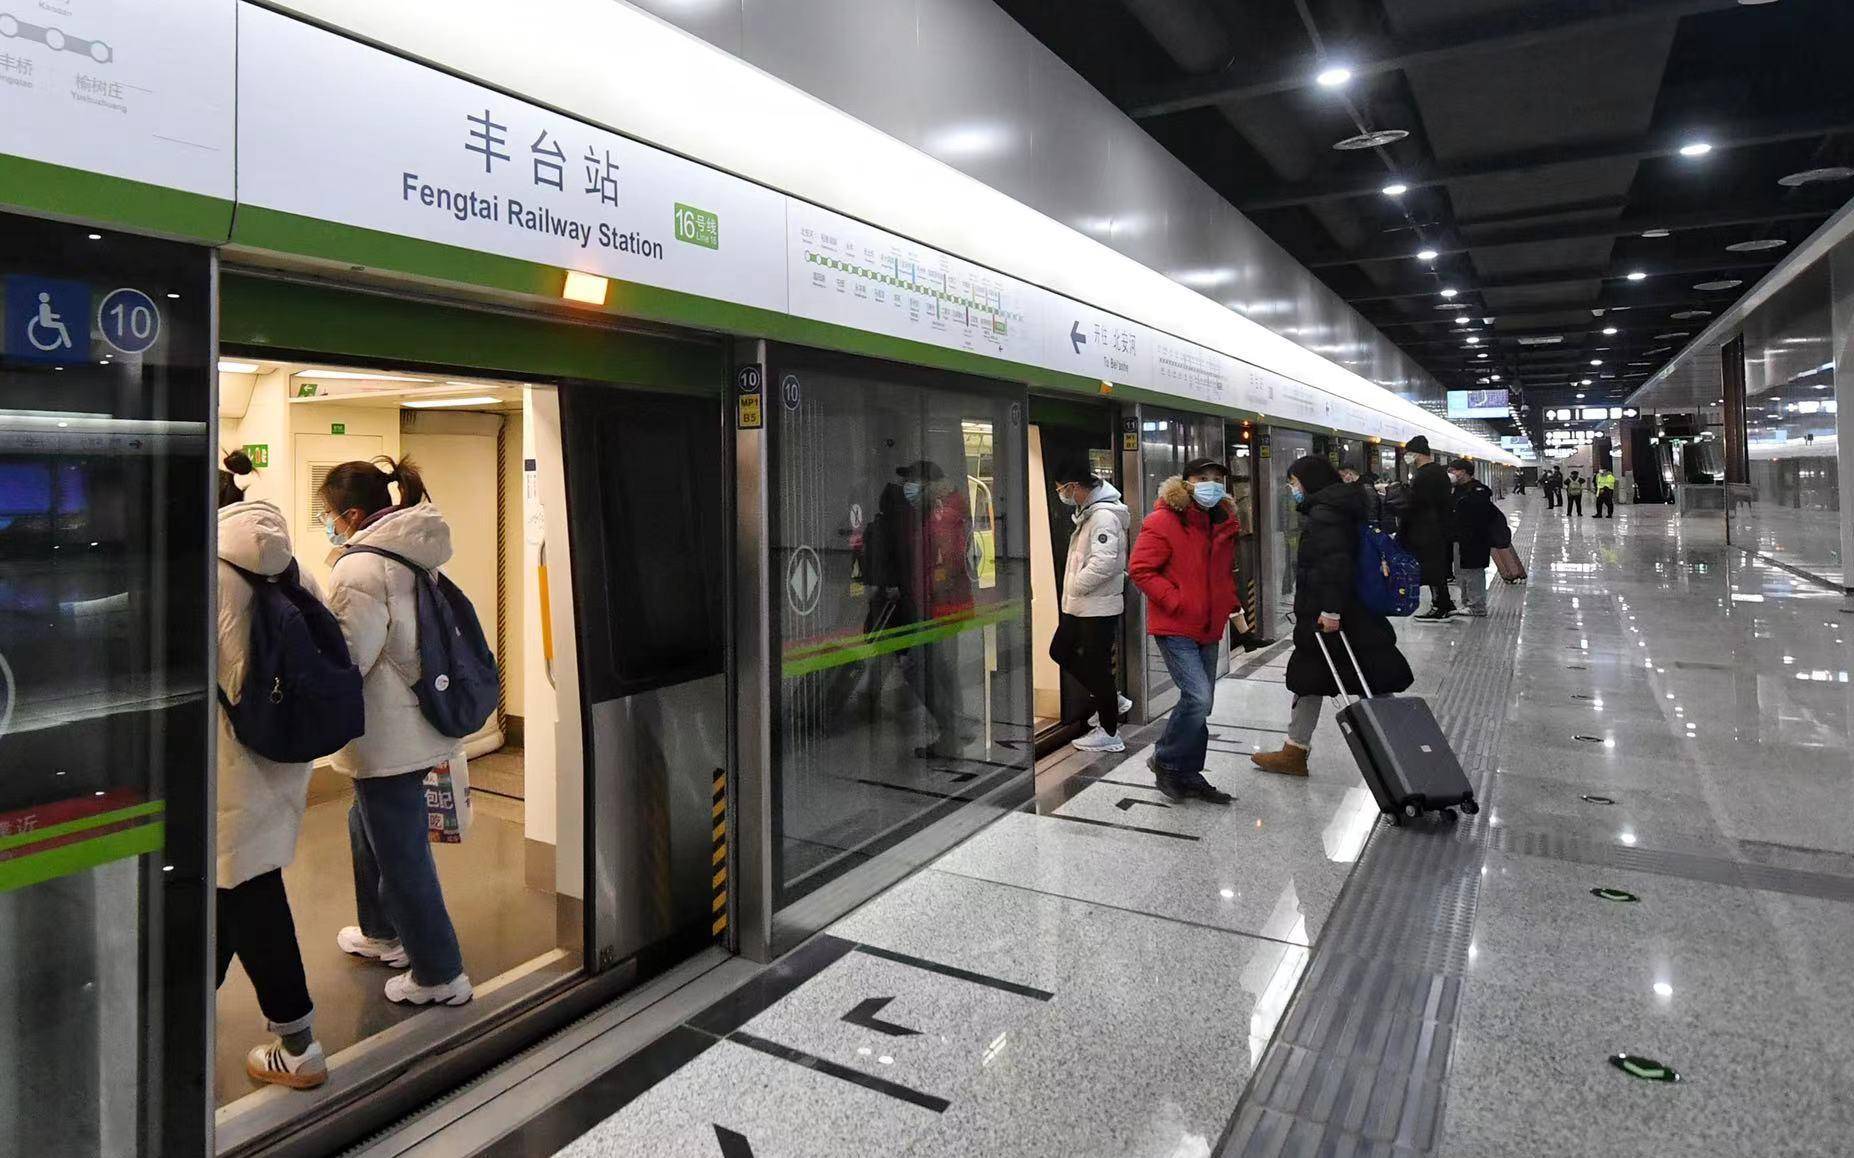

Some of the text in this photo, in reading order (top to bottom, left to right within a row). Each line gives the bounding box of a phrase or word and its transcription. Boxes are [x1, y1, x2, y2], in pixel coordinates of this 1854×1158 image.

[464, 109, 620, 208] 丰台站
[402, 172, 664, 260] Fengtai Railway Station
[110, 303, 151, 339] 10
[741, 372, 757, 387] 10
[785, 384, 799, 402] 10
[741, 398, 759, 407] MP1
[743, 413, 756, 423] B5
